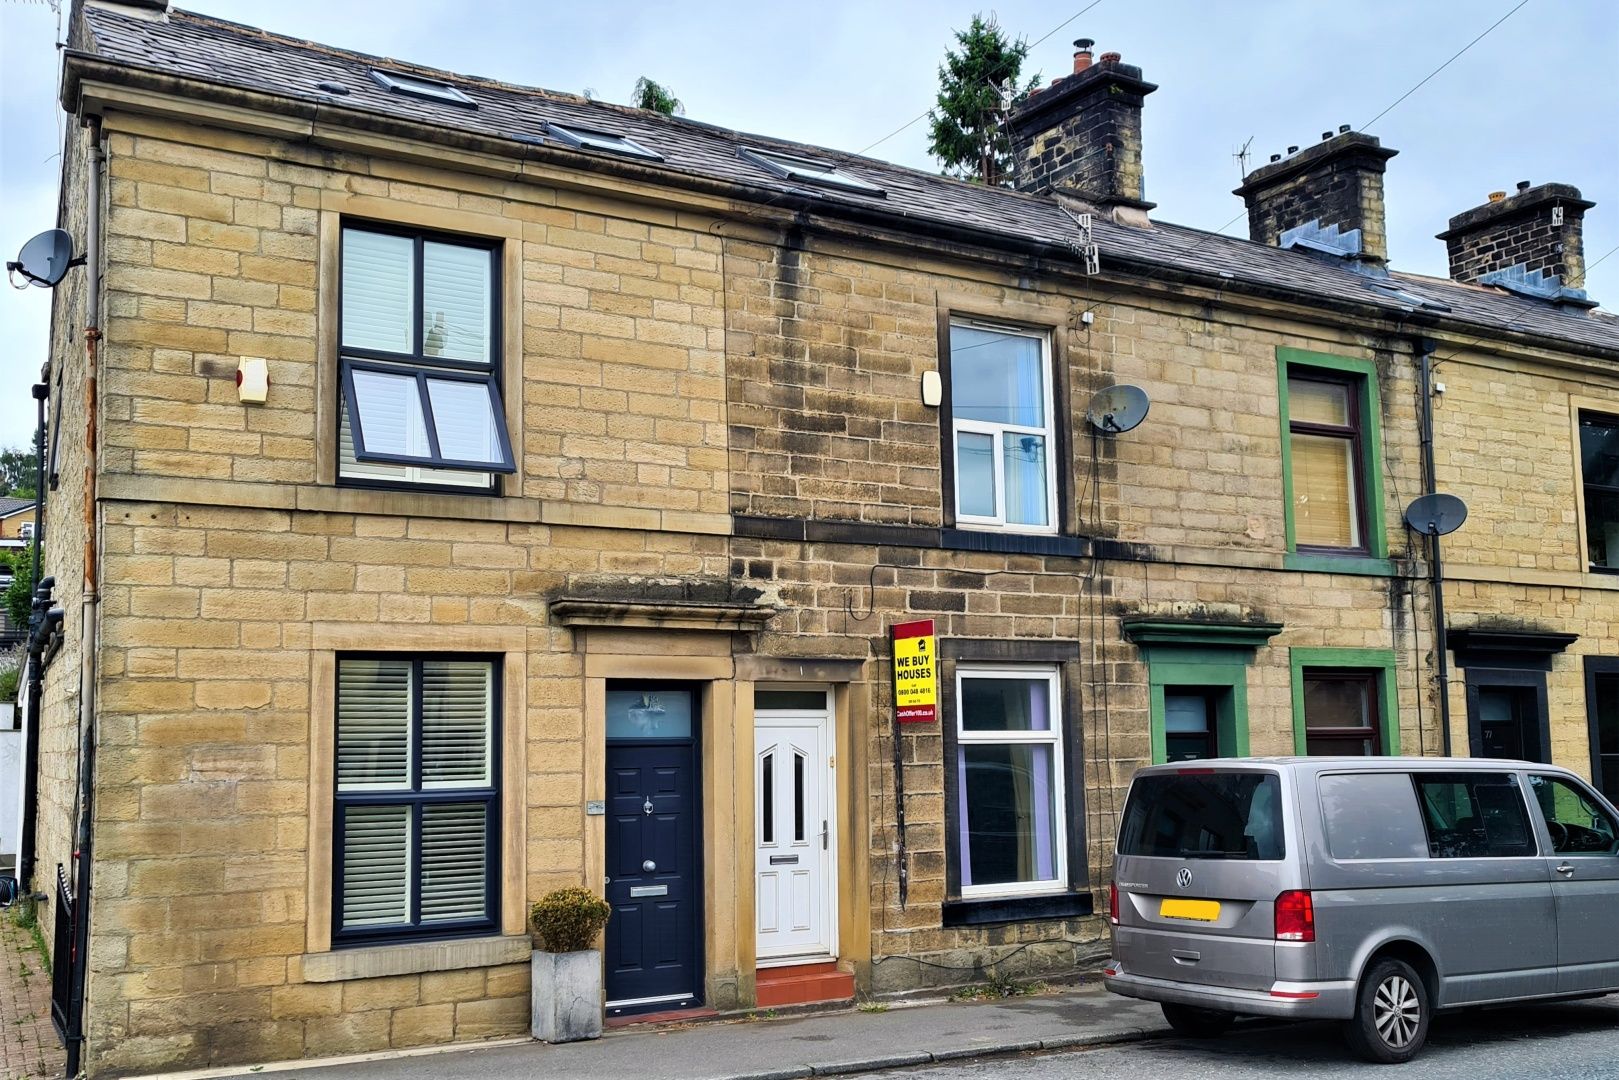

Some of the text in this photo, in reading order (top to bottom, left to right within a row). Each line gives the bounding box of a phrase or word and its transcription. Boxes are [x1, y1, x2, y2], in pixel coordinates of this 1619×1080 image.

[897, 655, 929, 667] WE BUY
[897, 668, 931, 680] HOUSES
